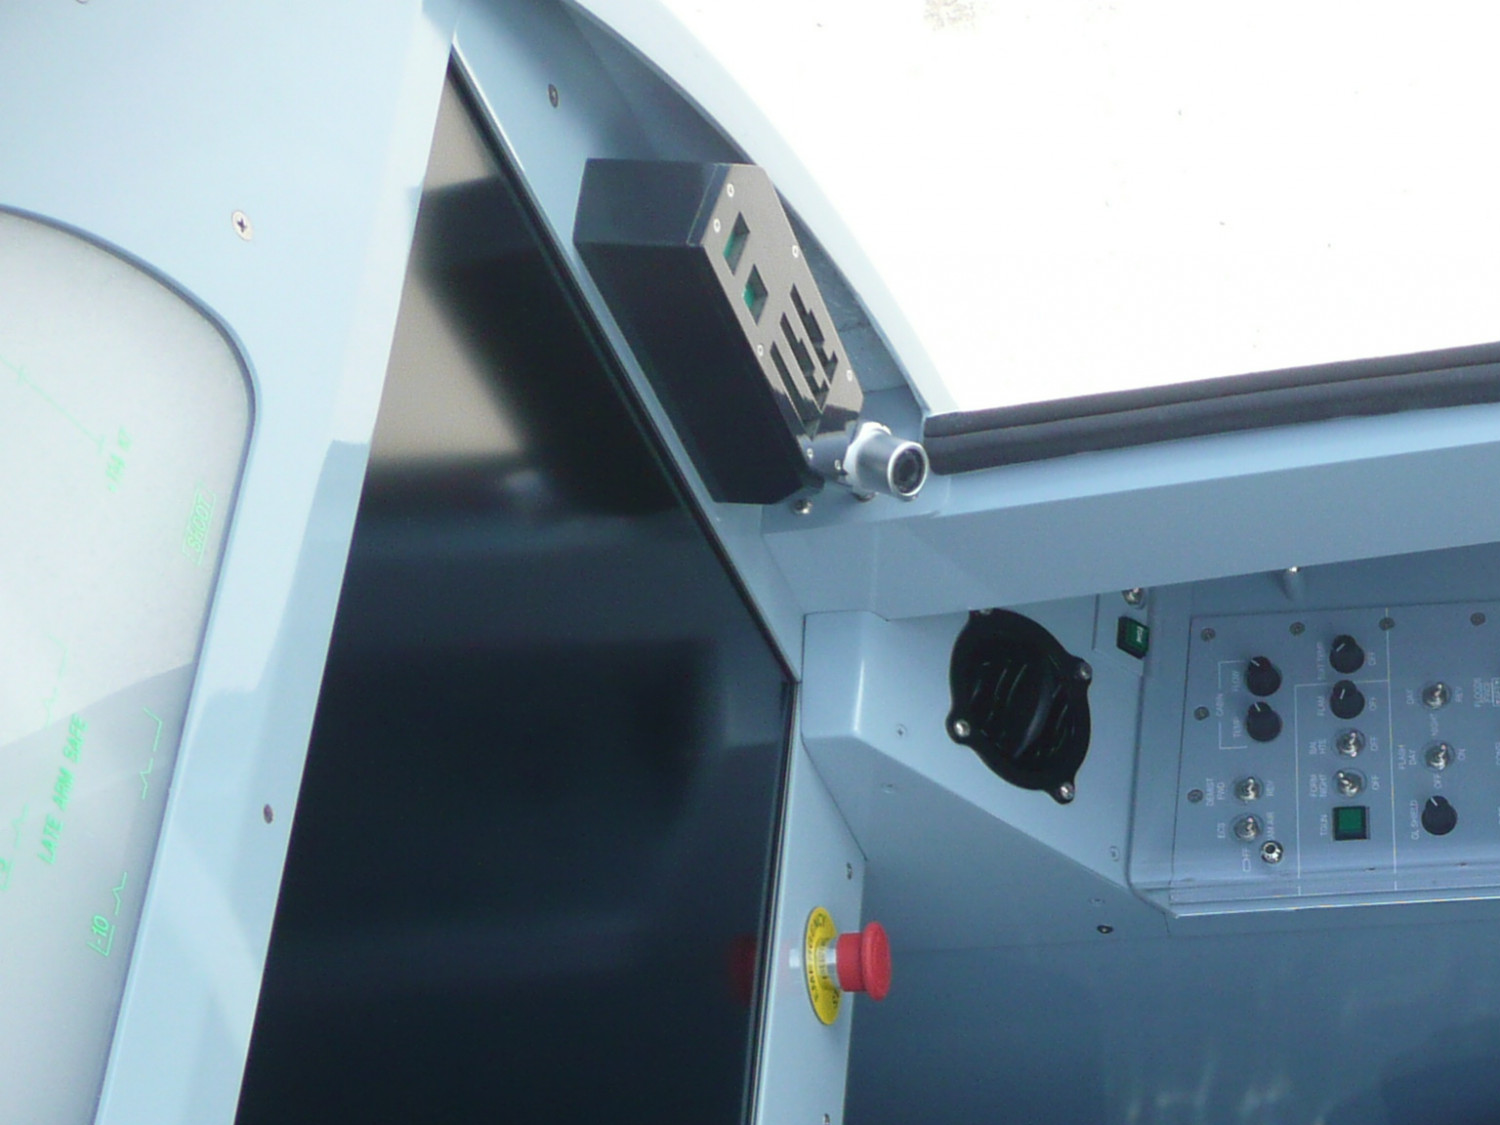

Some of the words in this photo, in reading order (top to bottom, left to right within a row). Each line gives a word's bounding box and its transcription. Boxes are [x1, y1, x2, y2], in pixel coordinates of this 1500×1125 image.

[185, 494, 210, 553] SHOOT
[61, 714, 89, 761] SAFE
[1408, 749, 1416, 765] DAY
[50, 768, 76, 809] ARM
[37, 819, 64, 861] LATE
